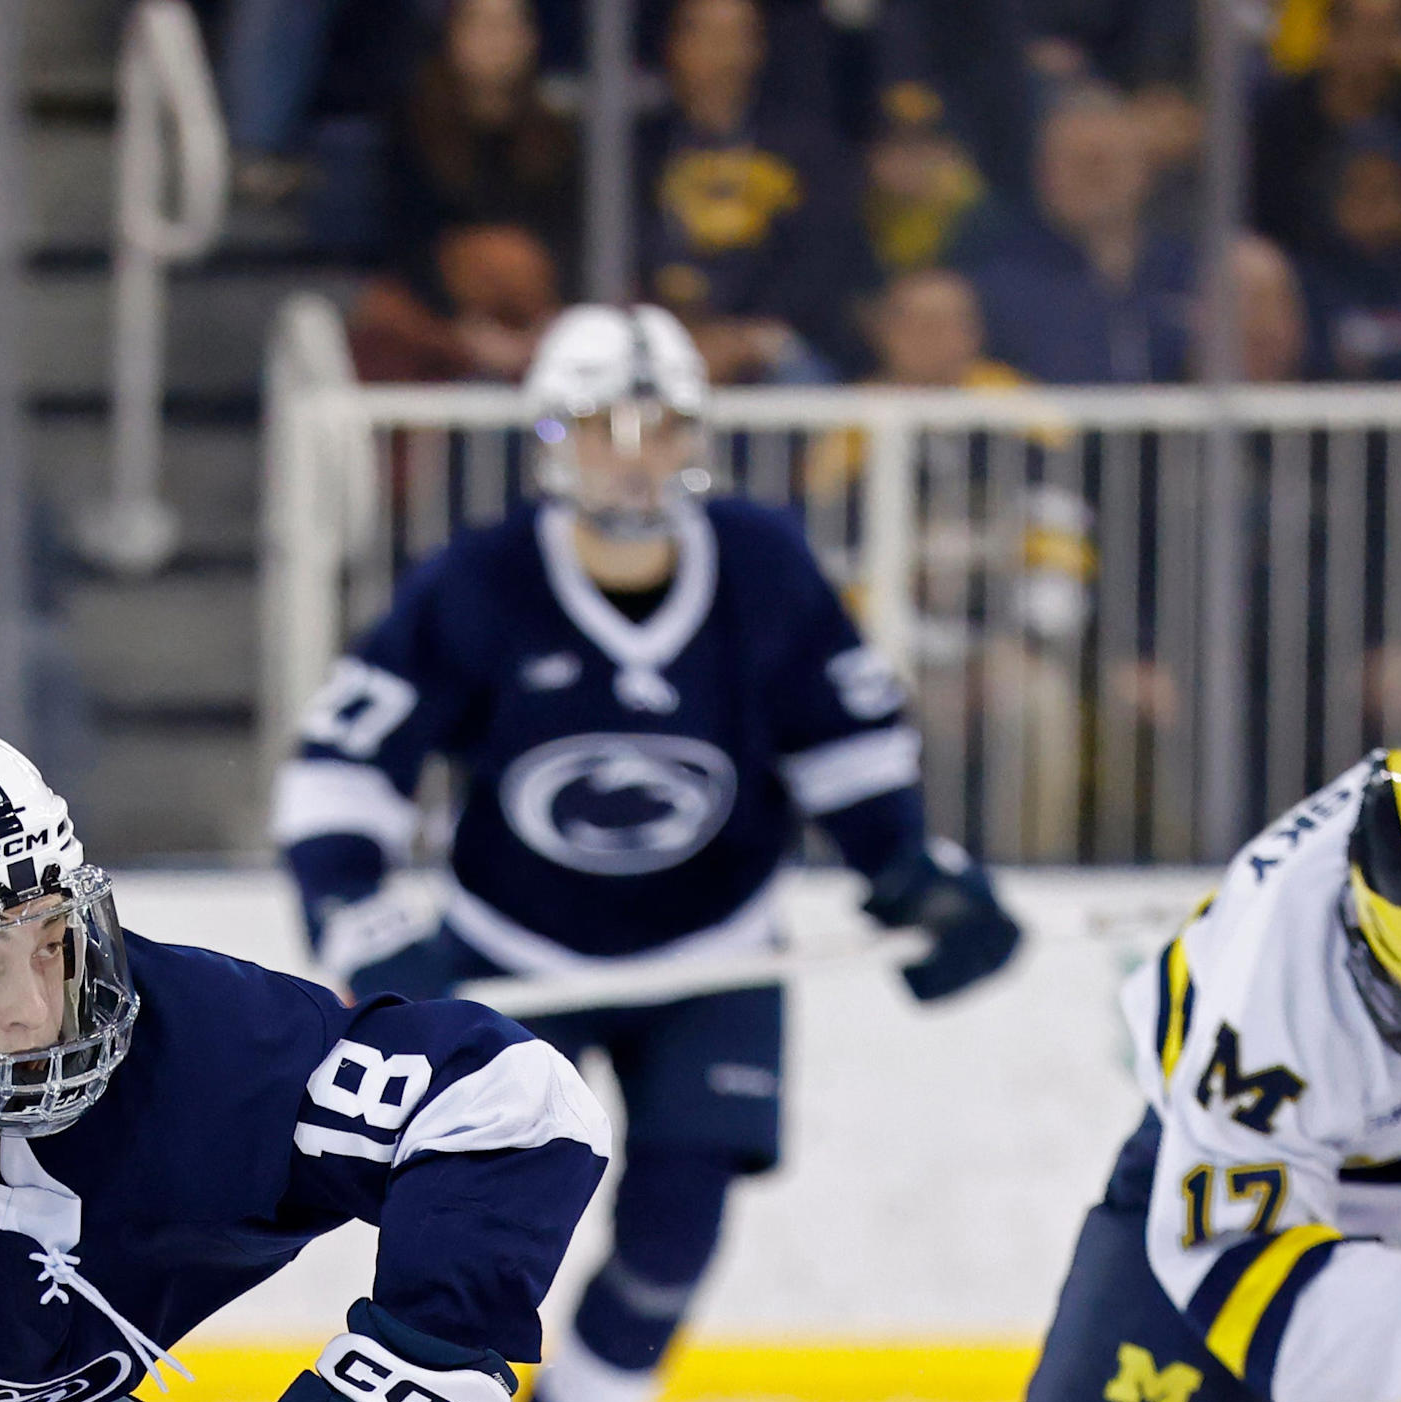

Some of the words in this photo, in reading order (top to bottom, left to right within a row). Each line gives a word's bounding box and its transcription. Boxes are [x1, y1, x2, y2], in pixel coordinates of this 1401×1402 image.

[294, 1038, 434, 1165] 18
[1195, 1019, 1308, 1135] M
[1181, 1162, 1287, 1250] 17
